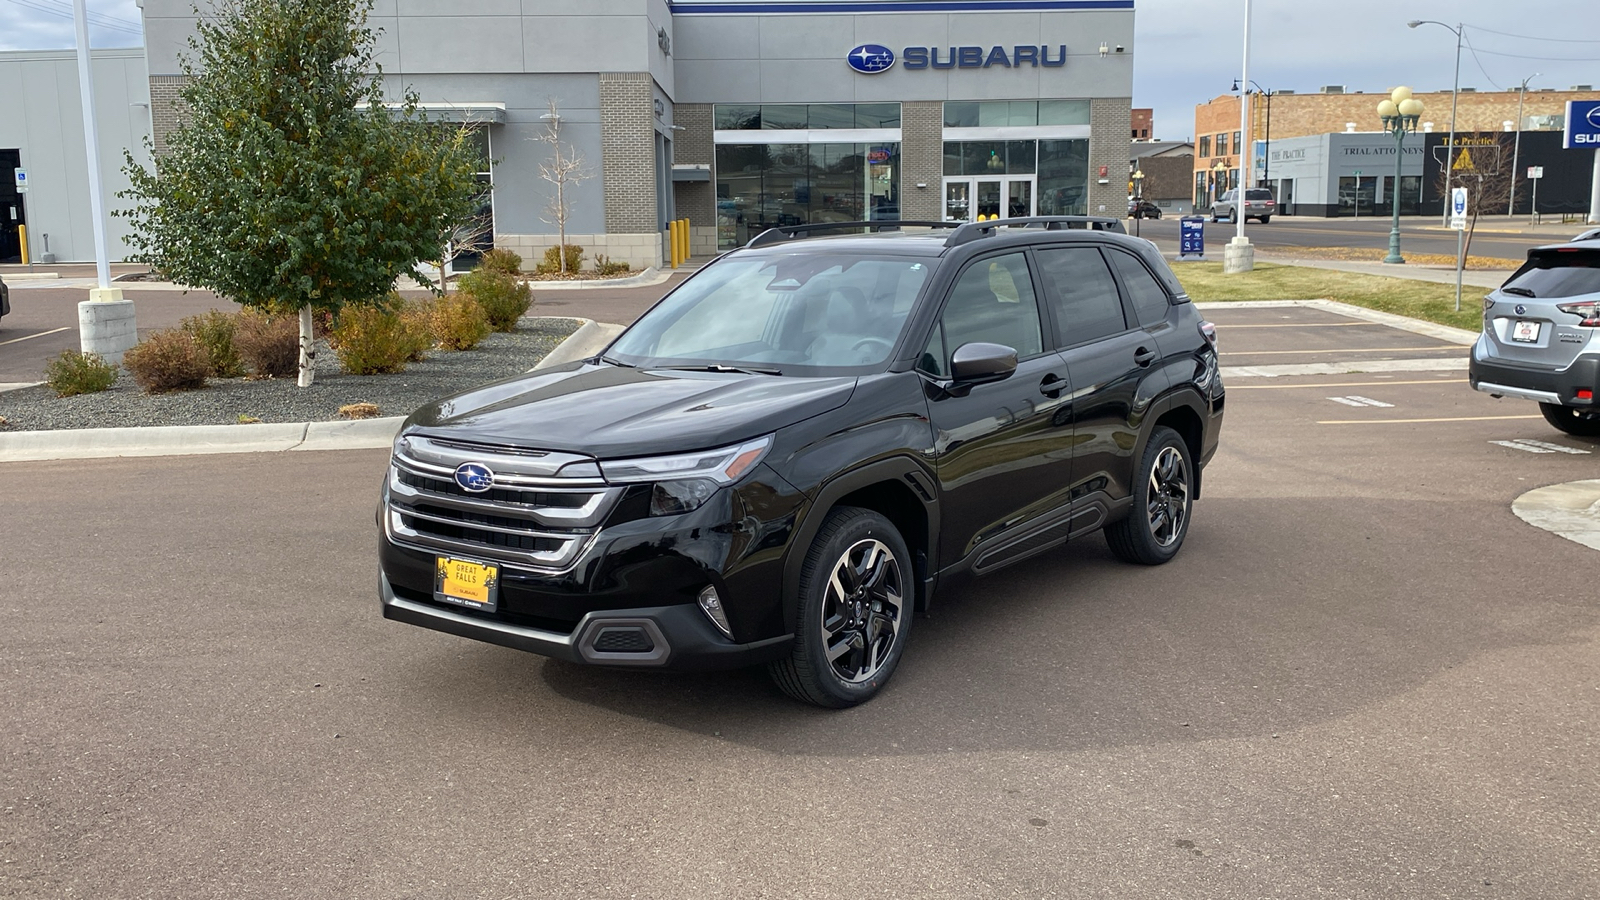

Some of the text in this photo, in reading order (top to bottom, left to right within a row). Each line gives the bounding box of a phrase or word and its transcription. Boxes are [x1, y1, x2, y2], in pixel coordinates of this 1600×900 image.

[903, 45, 1066, 70] SUBARU
[1442, 137, 1459, 145] Te
[1574, 133, 1600, 143] SU
[868, 152, 888, 161] OPEN
[1271, 148, 1305, 160] THE PRACTICE
[1344, 147, 1424, 156] TRIAL ATTONEYS
[456, 564, 477, 574] GREAT
[455, 572, 477, 584] FALLS
[459, 588, 478, 597] SUBARU
